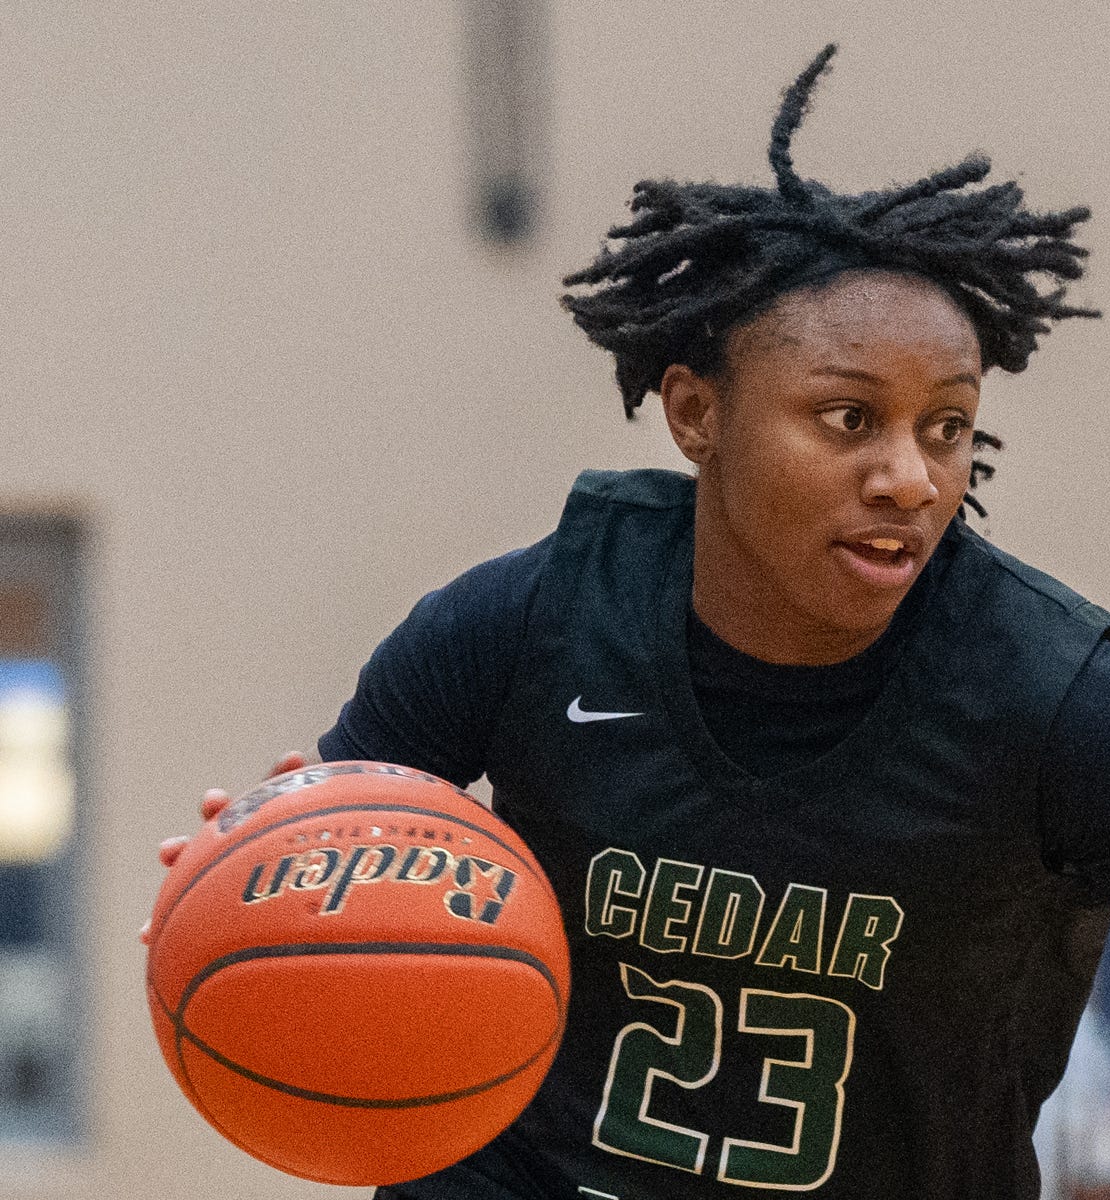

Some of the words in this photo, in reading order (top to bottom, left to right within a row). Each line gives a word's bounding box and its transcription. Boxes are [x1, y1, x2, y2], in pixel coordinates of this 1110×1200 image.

[242, 844, 518, 926] Baden
[585, 846, 905, 991] CEDAR
[591, 962, 857, 1192] 23
